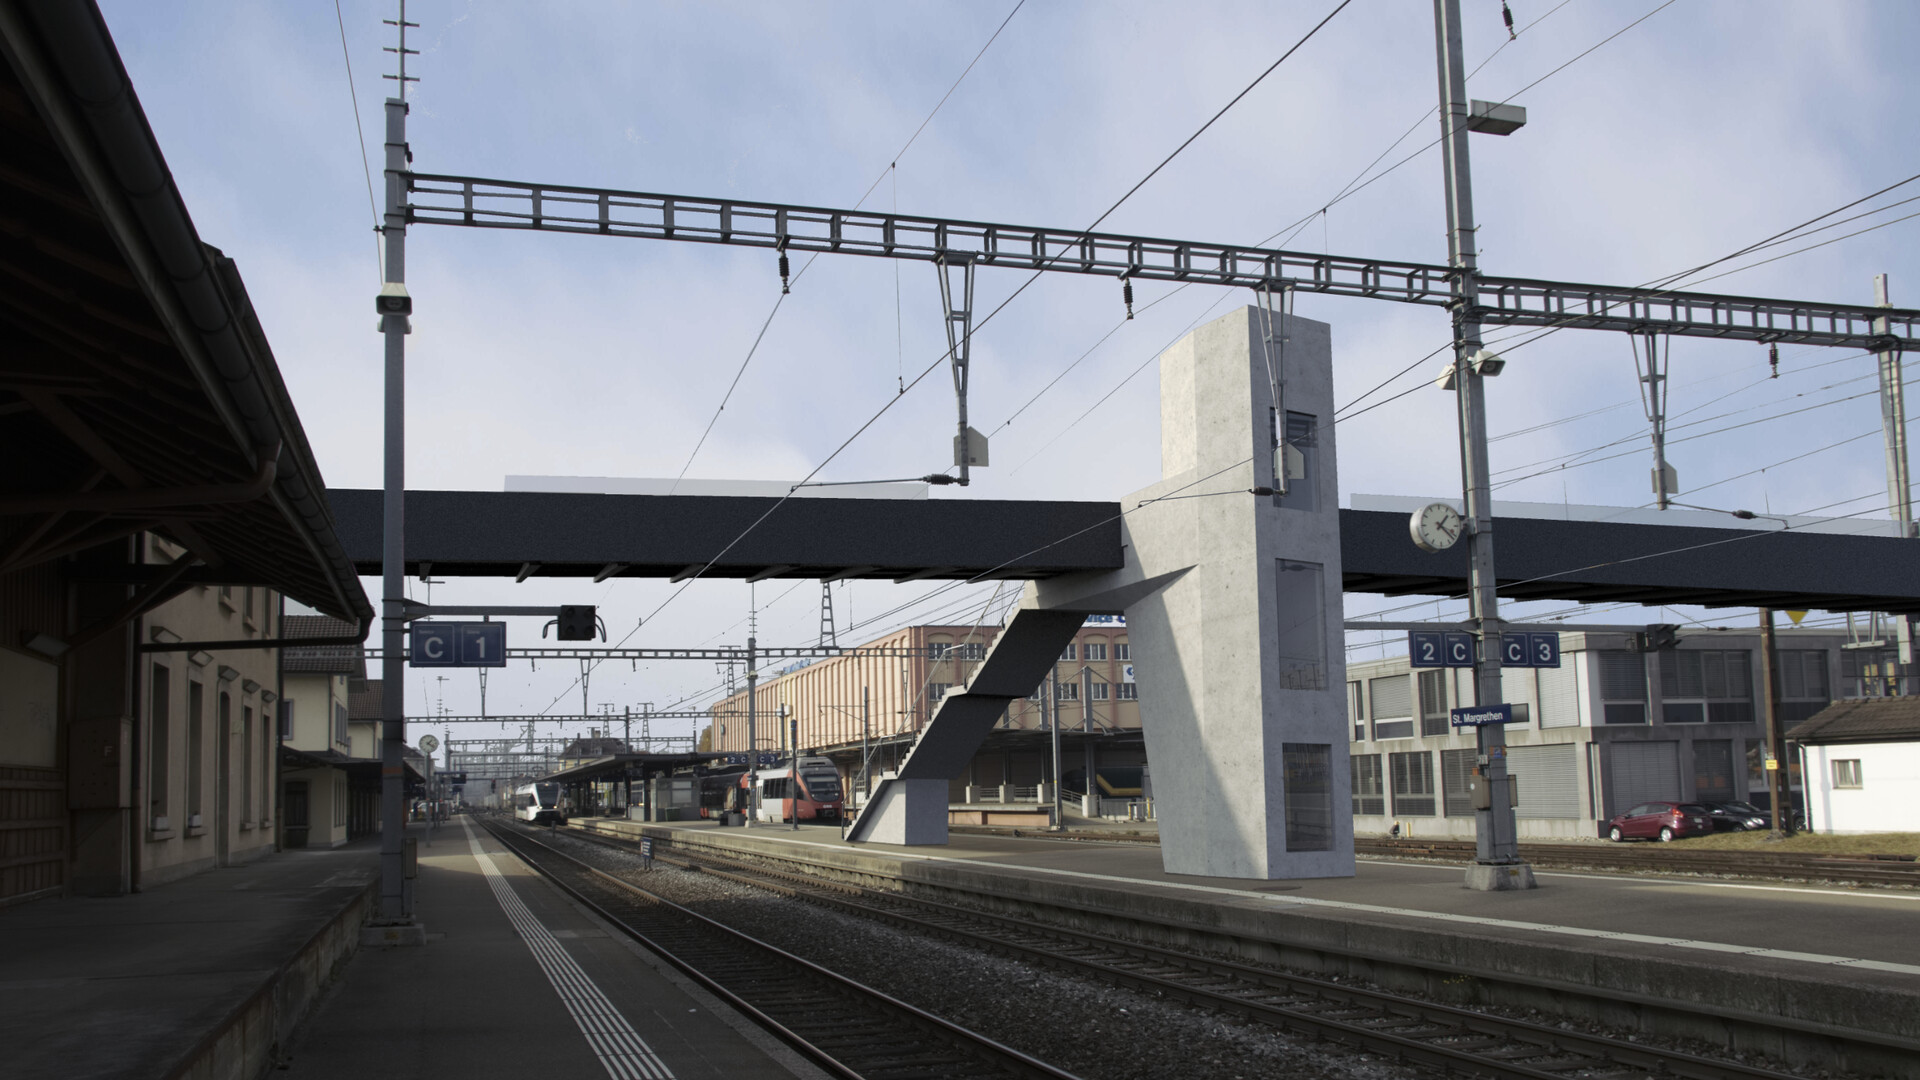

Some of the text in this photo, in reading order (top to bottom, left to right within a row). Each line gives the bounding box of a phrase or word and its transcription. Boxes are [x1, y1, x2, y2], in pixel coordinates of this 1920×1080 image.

[424, 637, 485, 658] C 1
[1423, 643, 1466, 660] 2 C
[1508, 644, 1551, 661] C 3
[1452, 711, 1503, 724] St. Margrethen
[104, 746, 112, 757] F
